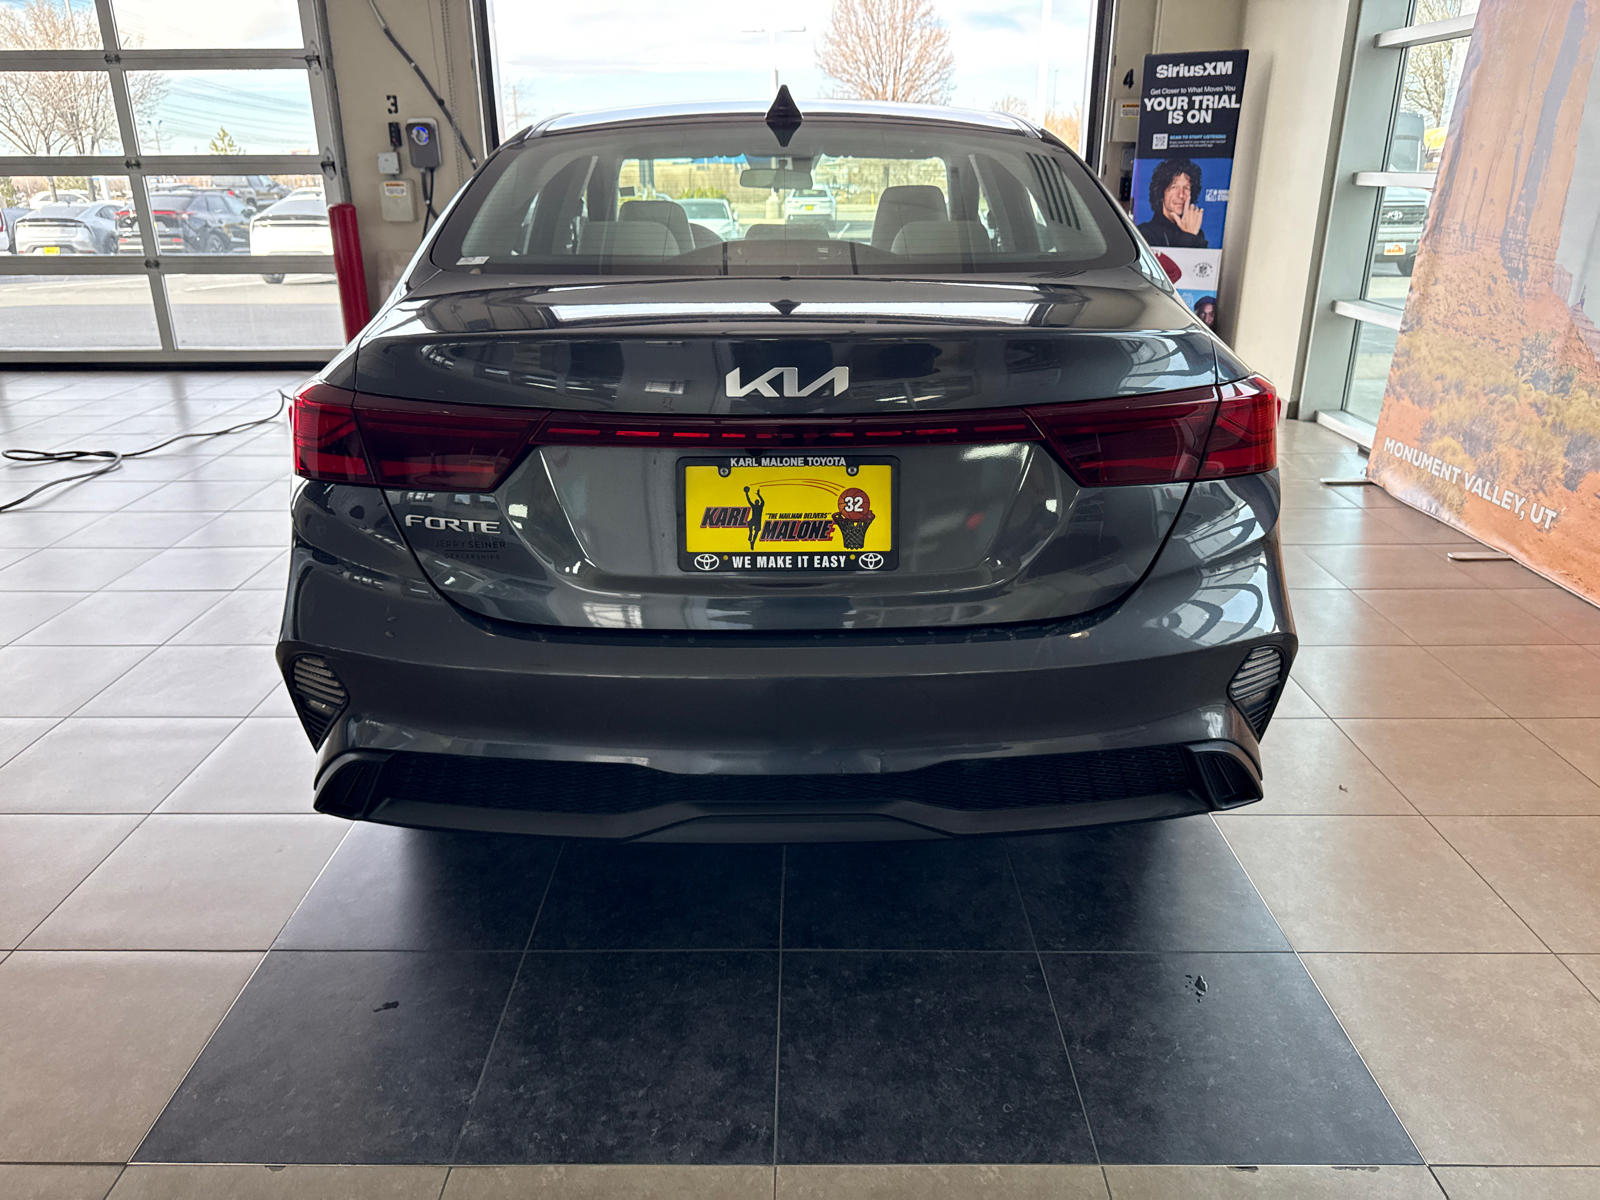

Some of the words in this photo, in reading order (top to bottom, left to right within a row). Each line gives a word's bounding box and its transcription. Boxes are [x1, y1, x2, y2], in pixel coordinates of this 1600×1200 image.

[1156, 61, 1233, 78] SiriusXM
[1123, 69, 1134, 89] 4
[1162, 87, 1180, 95] Closer
[386, 95, 399, 114] 3
[1144, 96, 1189, 112] YOUR
[1191, 94, 1240, 109] TRIAL
[1168, 110, 1184, 124] IS
[1186, 109, 1213, 124] ON
[725, 366, 849, 397] KIA
[730, 457, 758, 467] KARL
[761, 457, 804, 466] MALONE
[806, 457, 847, 466] TOYOTA
[1383, 436, 1462, 485] MONUMENT
[1464, 471, 1526, 520] VALLEY,
[1529, 502, 1557, 529] UT
[844, 496, 864, 512] 32
[405, 514, 501, 534] FORTE
[700, 506, 751, 528] KARL
[759, 520, 836, 541] MALONE
[469, 541, 506, 549] SEINER
[731, 556, 751, 568] WE
[757, 556, 793, 568] MAKE
[797, 556, 809, 568] IT
[814, 555, 847, 568] EASY
